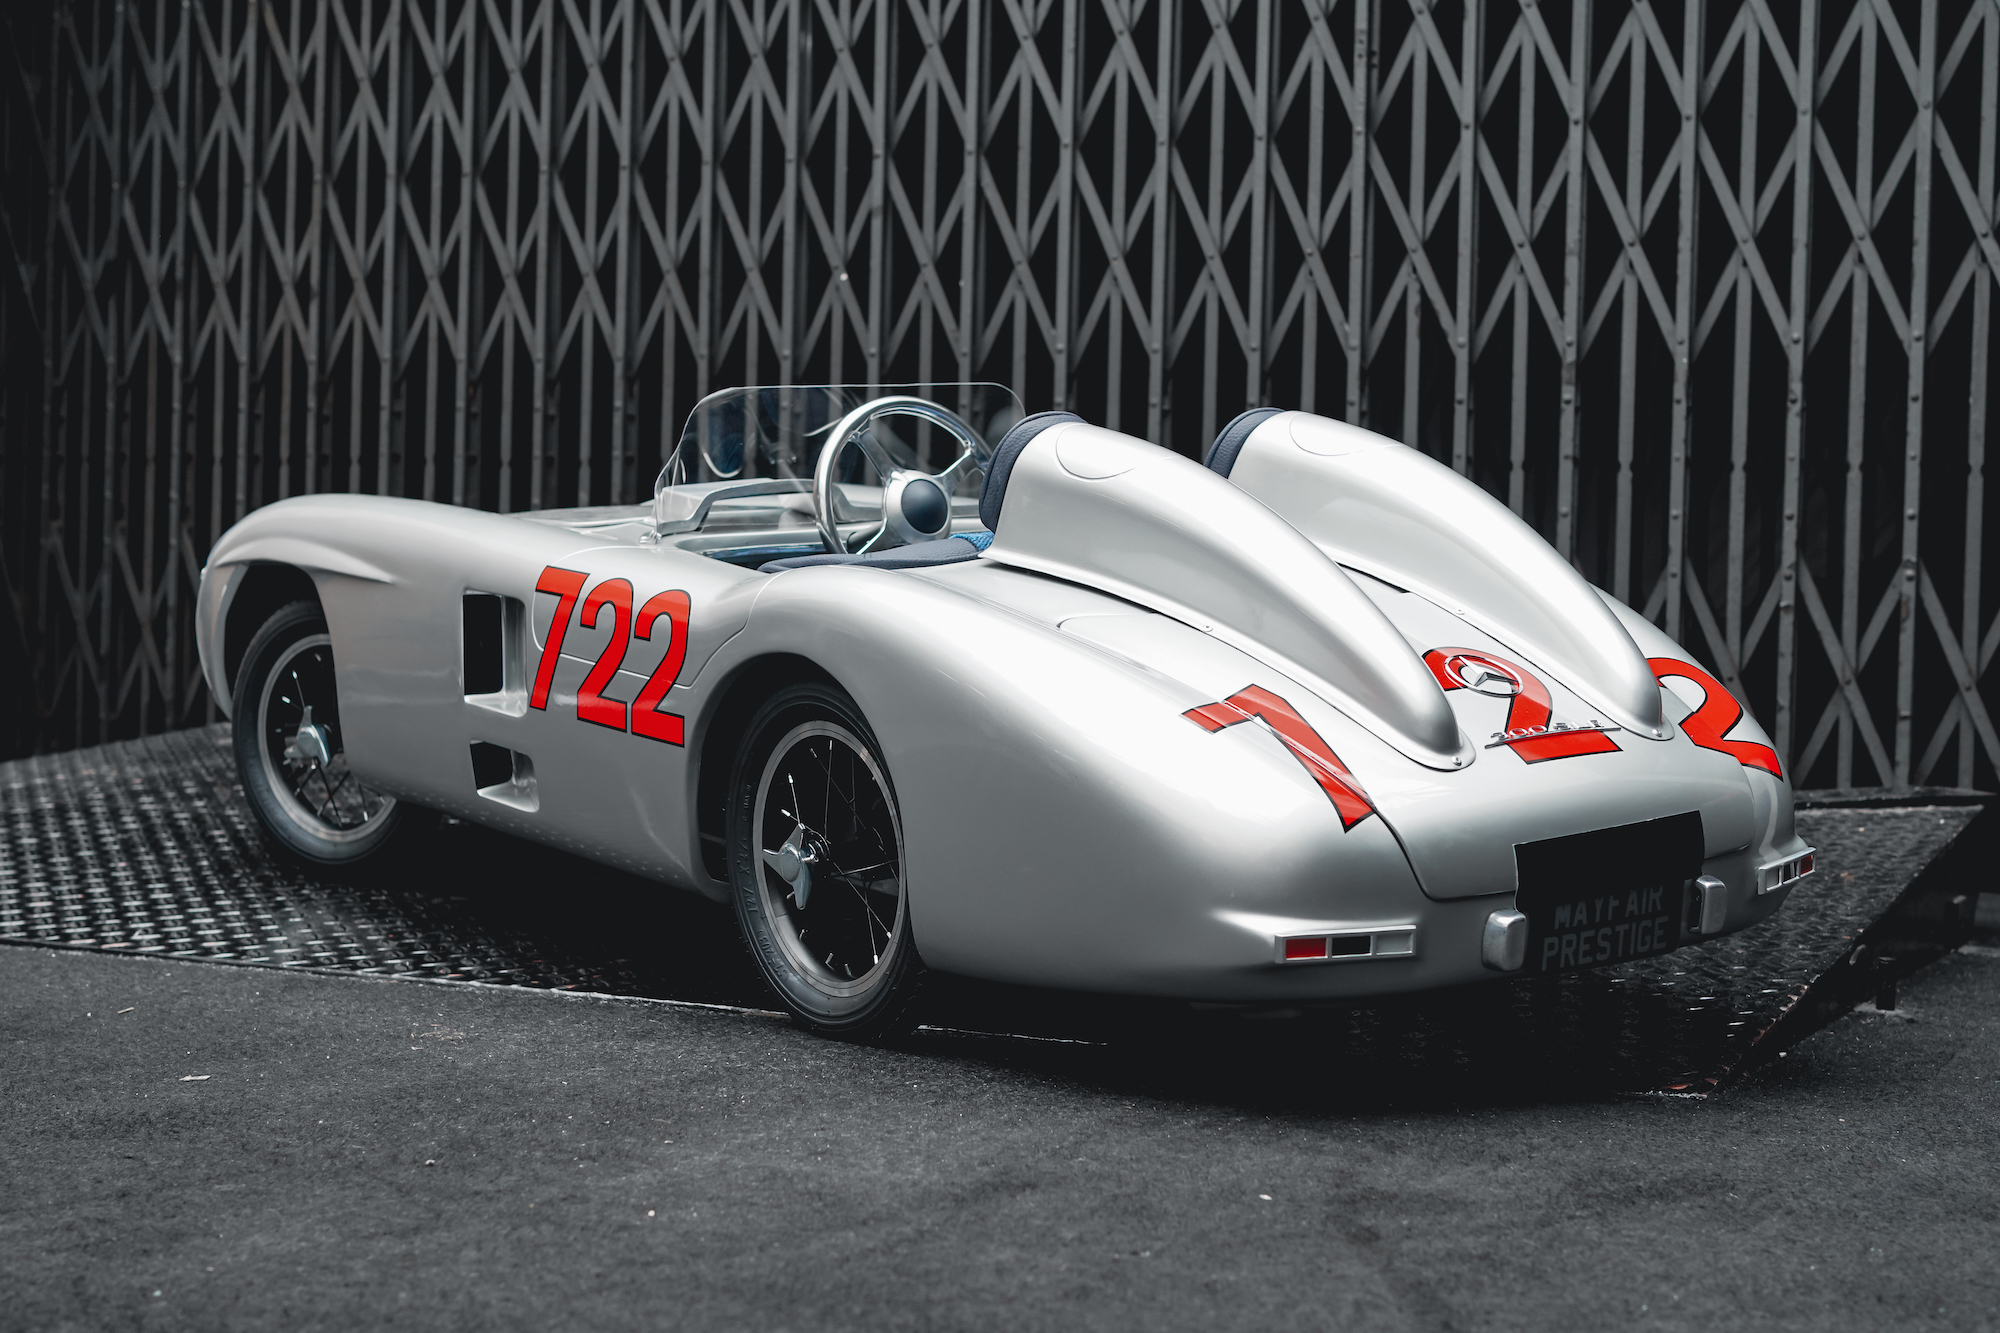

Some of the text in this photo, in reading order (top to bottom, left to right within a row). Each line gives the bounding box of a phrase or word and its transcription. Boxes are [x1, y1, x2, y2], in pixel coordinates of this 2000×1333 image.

[530, 565, 691, 748] 722
[1491, 724, 1547, 741] 300
[1554, 884, 1665, 930] MAYFAIR
[1541, 915, 1669, 972] PRESTIGE
